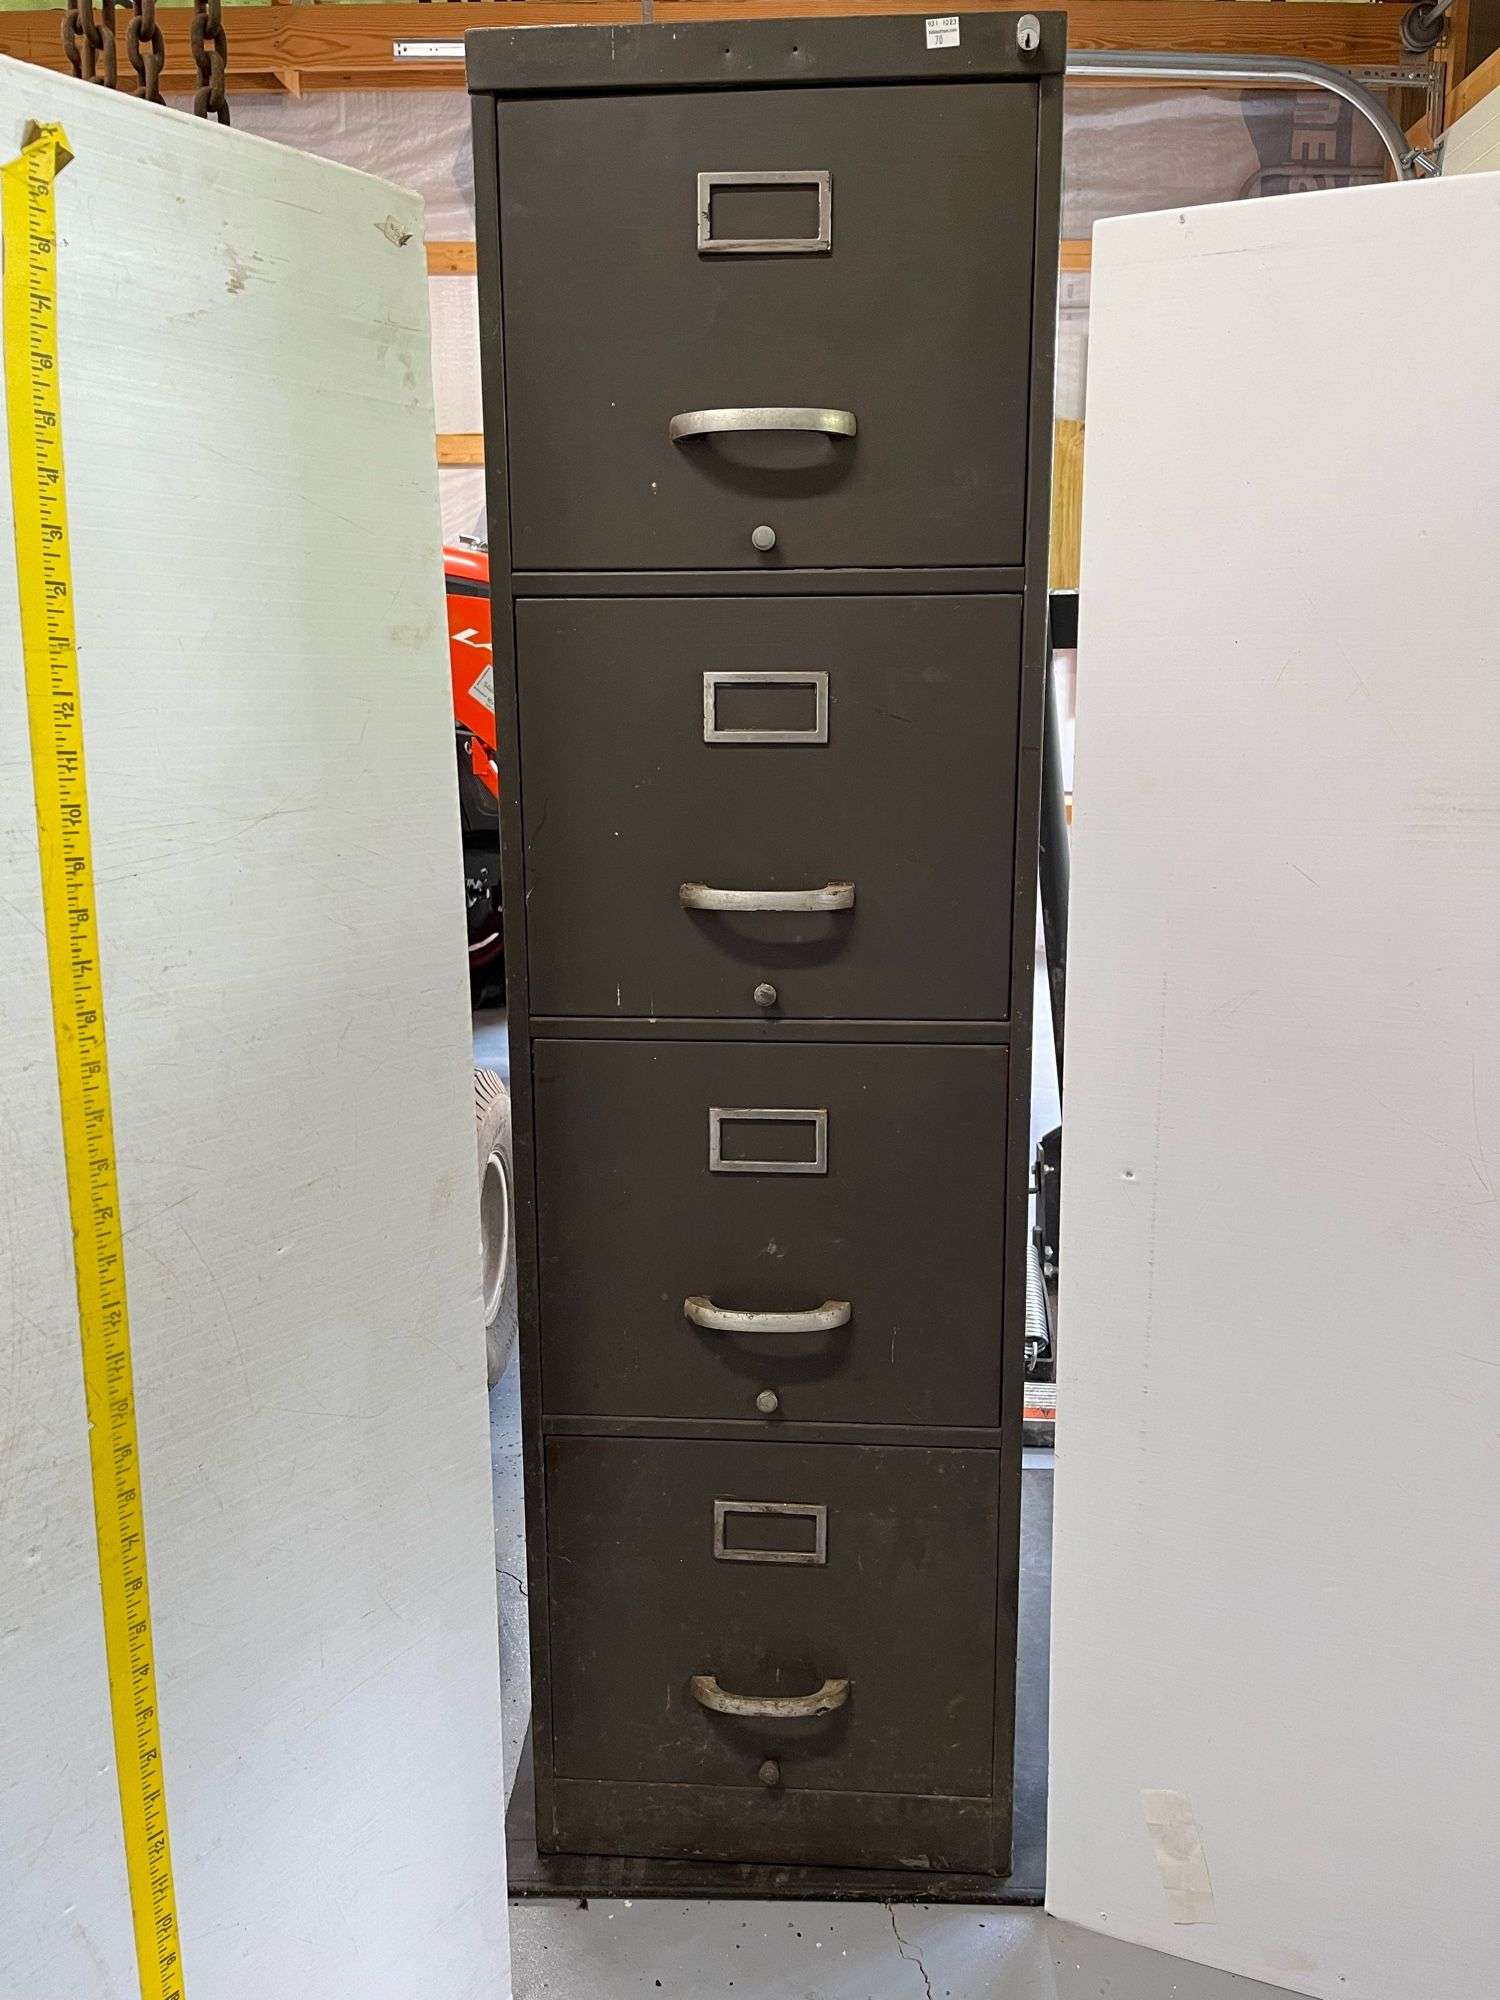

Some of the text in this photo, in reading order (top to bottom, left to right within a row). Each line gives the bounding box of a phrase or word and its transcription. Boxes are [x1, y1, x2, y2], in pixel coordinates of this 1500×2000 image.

[37, 185, 48, 195] 9
[38, 243, 50, 253] 8
[38, 300, 50, 311] 7
[40, 359, 52, 369] 6
[42, 416, 55, 426] 5
[46, 473, 59, 483] 4
[50, 530, 62, 540] 3
[54, 586, 66, 596] 2
[61, 702, 74, 719] 12
[65, 757, 78, 773] 11
[69, 809, 82, 826] 10
[73, 862, 85, 871] 9
[77, 913, 88, 922] 8
[81, 965, 92, 973] 7
[85, 1015, 96, 1024] 6
[89, 1065, 101, 1073] 5
